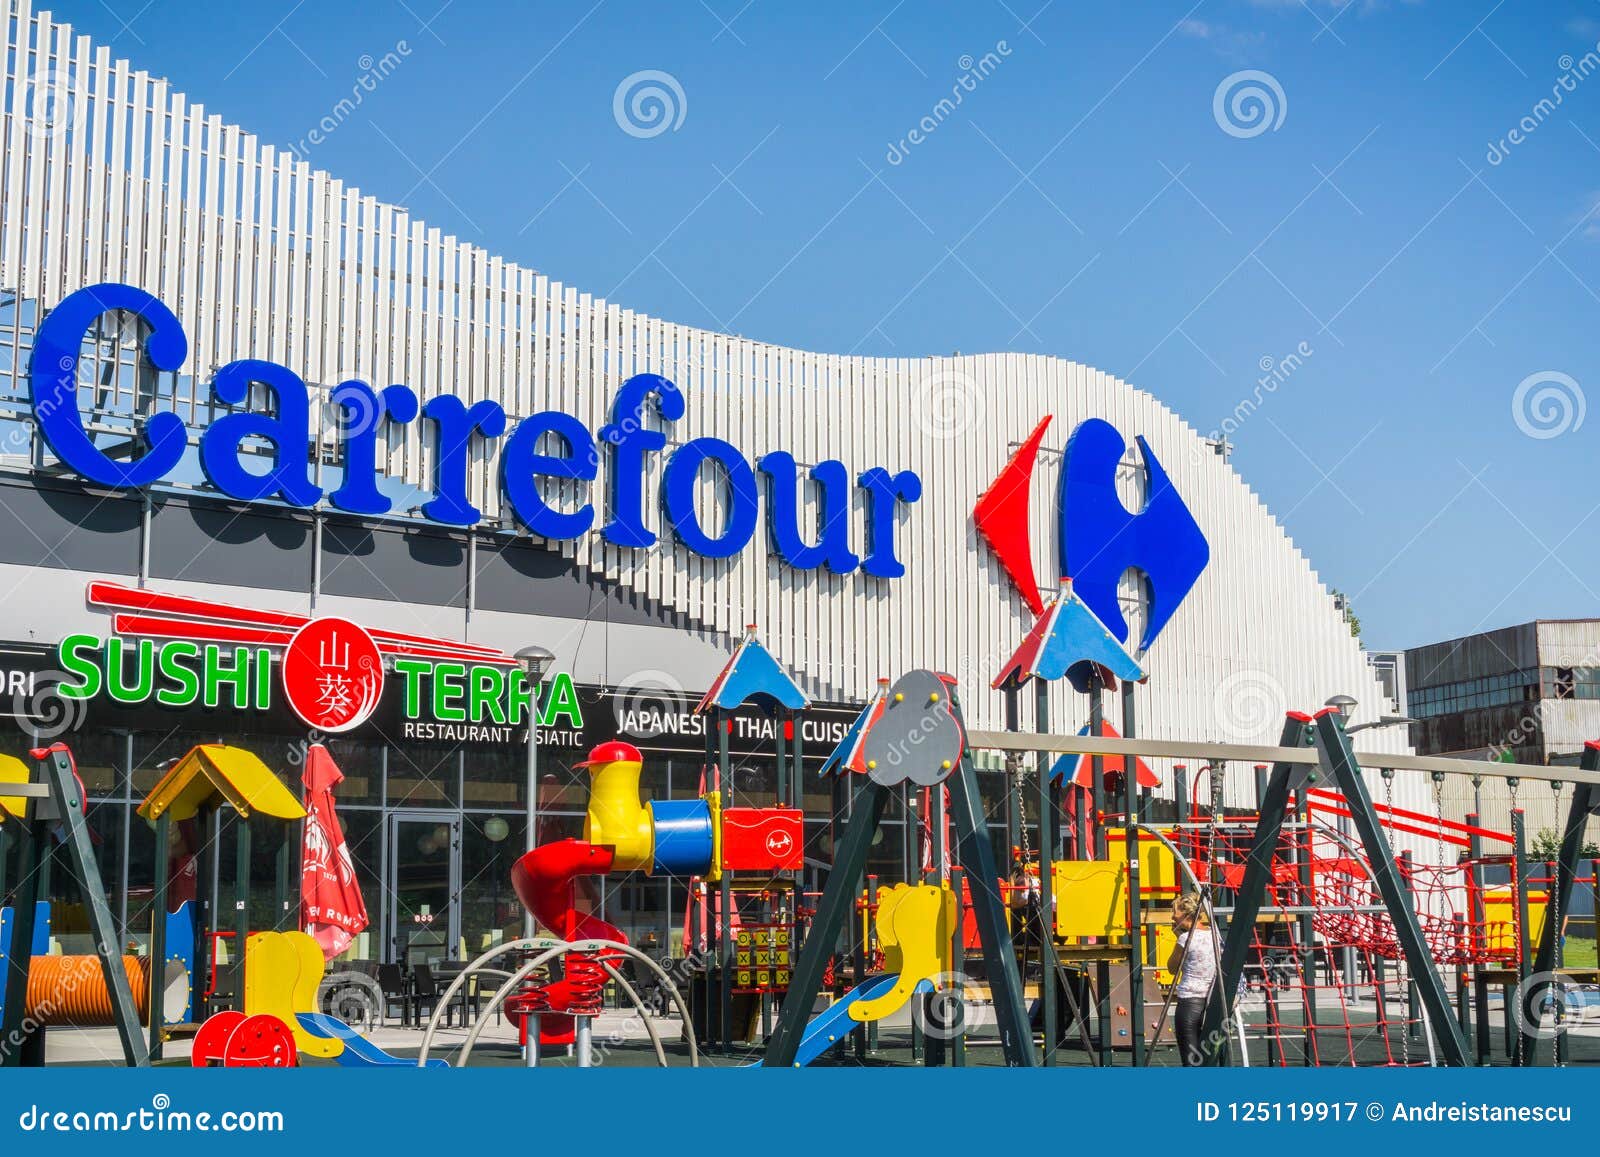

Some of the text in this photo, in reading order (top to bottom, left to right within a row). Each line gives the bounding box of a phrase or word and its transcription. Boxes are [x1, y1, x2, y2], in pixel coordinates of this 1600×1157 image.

[28, 283, 922, 579] Carrefour
[0, 670, 35, 697] RI
[56, 634, 271, 710] SUSHI
[394, 659, 584, 728] TERRA
[404, 721, 513, 744] RESTAURANT
[802, 720, 853, 743] CUISI
